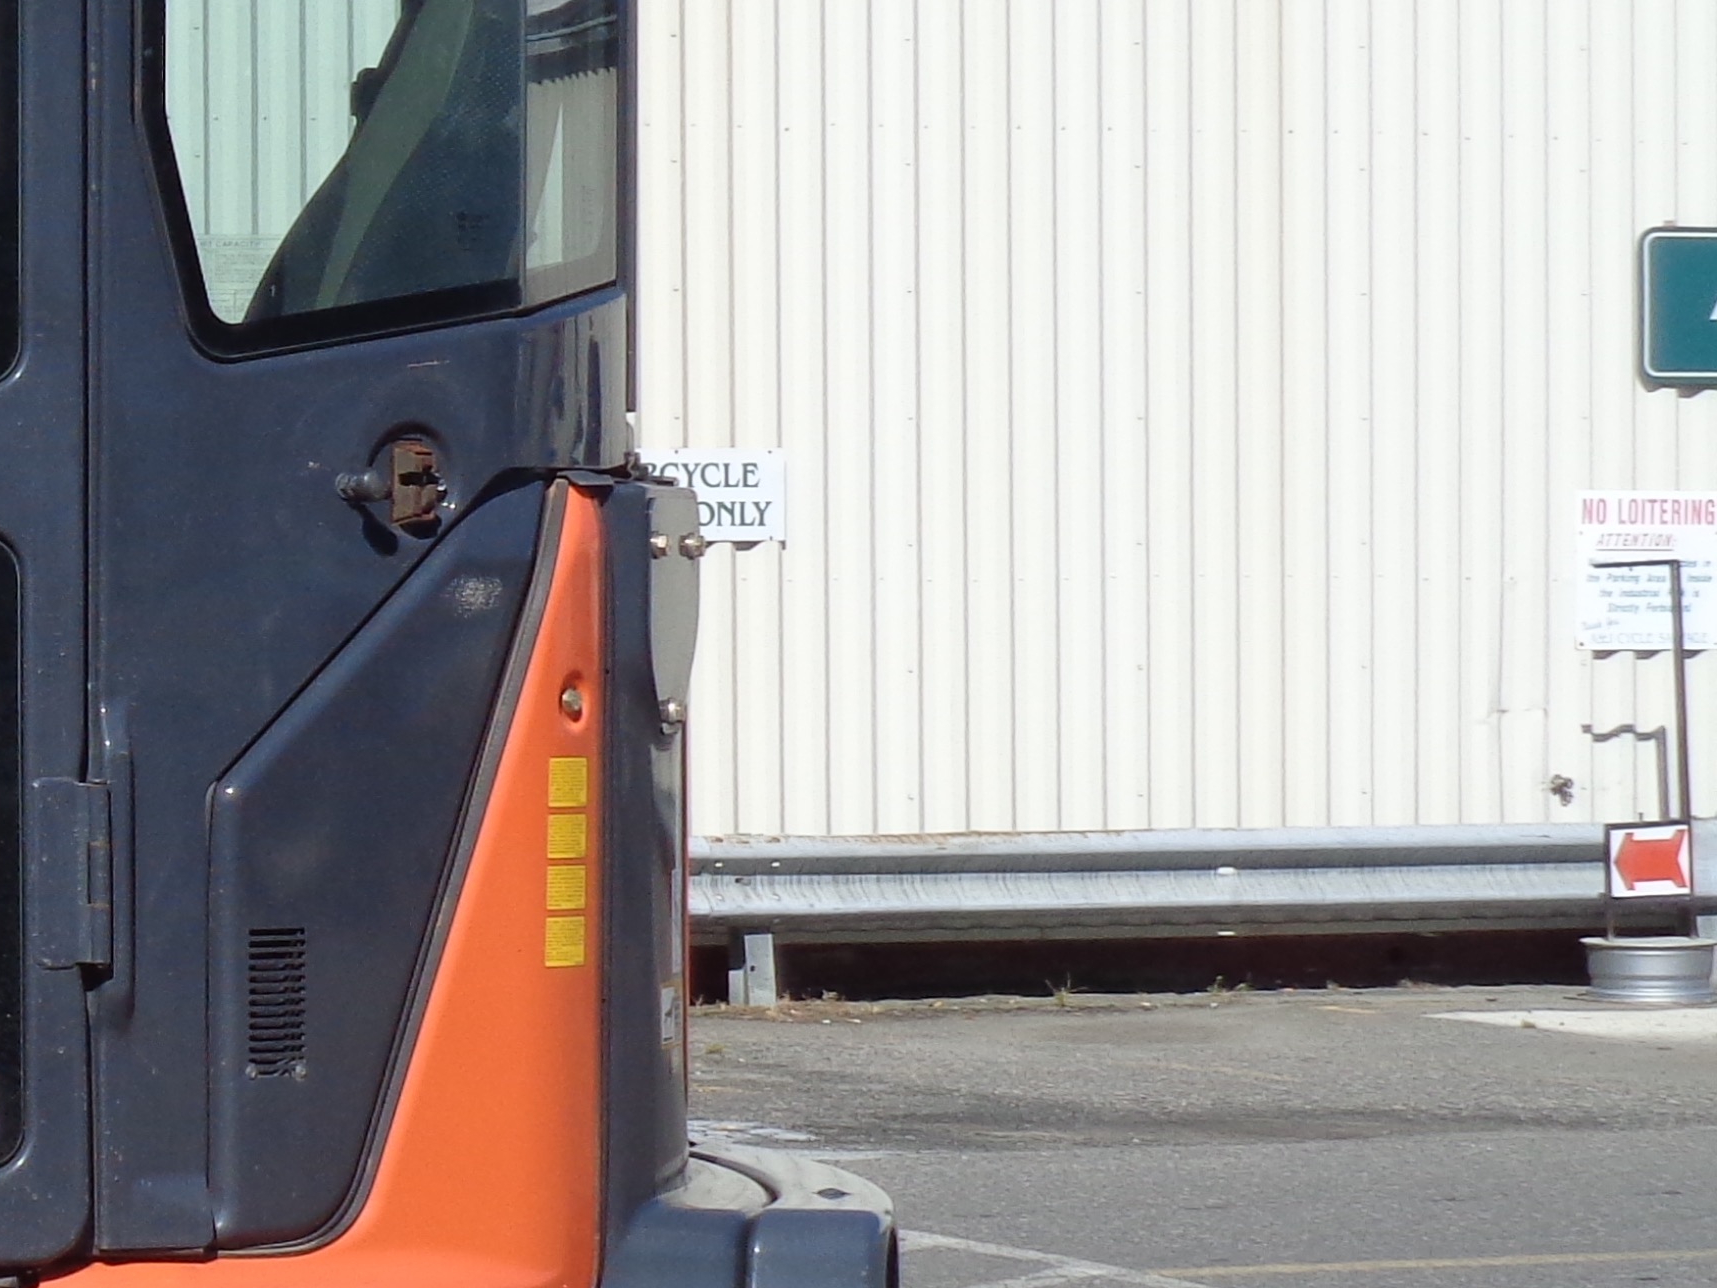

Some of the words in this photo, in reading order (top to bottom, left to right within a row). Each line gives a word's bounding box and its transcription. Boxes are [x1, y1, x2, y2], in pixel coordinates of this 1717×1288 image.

[697, 500, 773, 527] ONLY
[1581, 497, 1607, 525] NO
[1617, 497, 1716, 526] LOITERING
